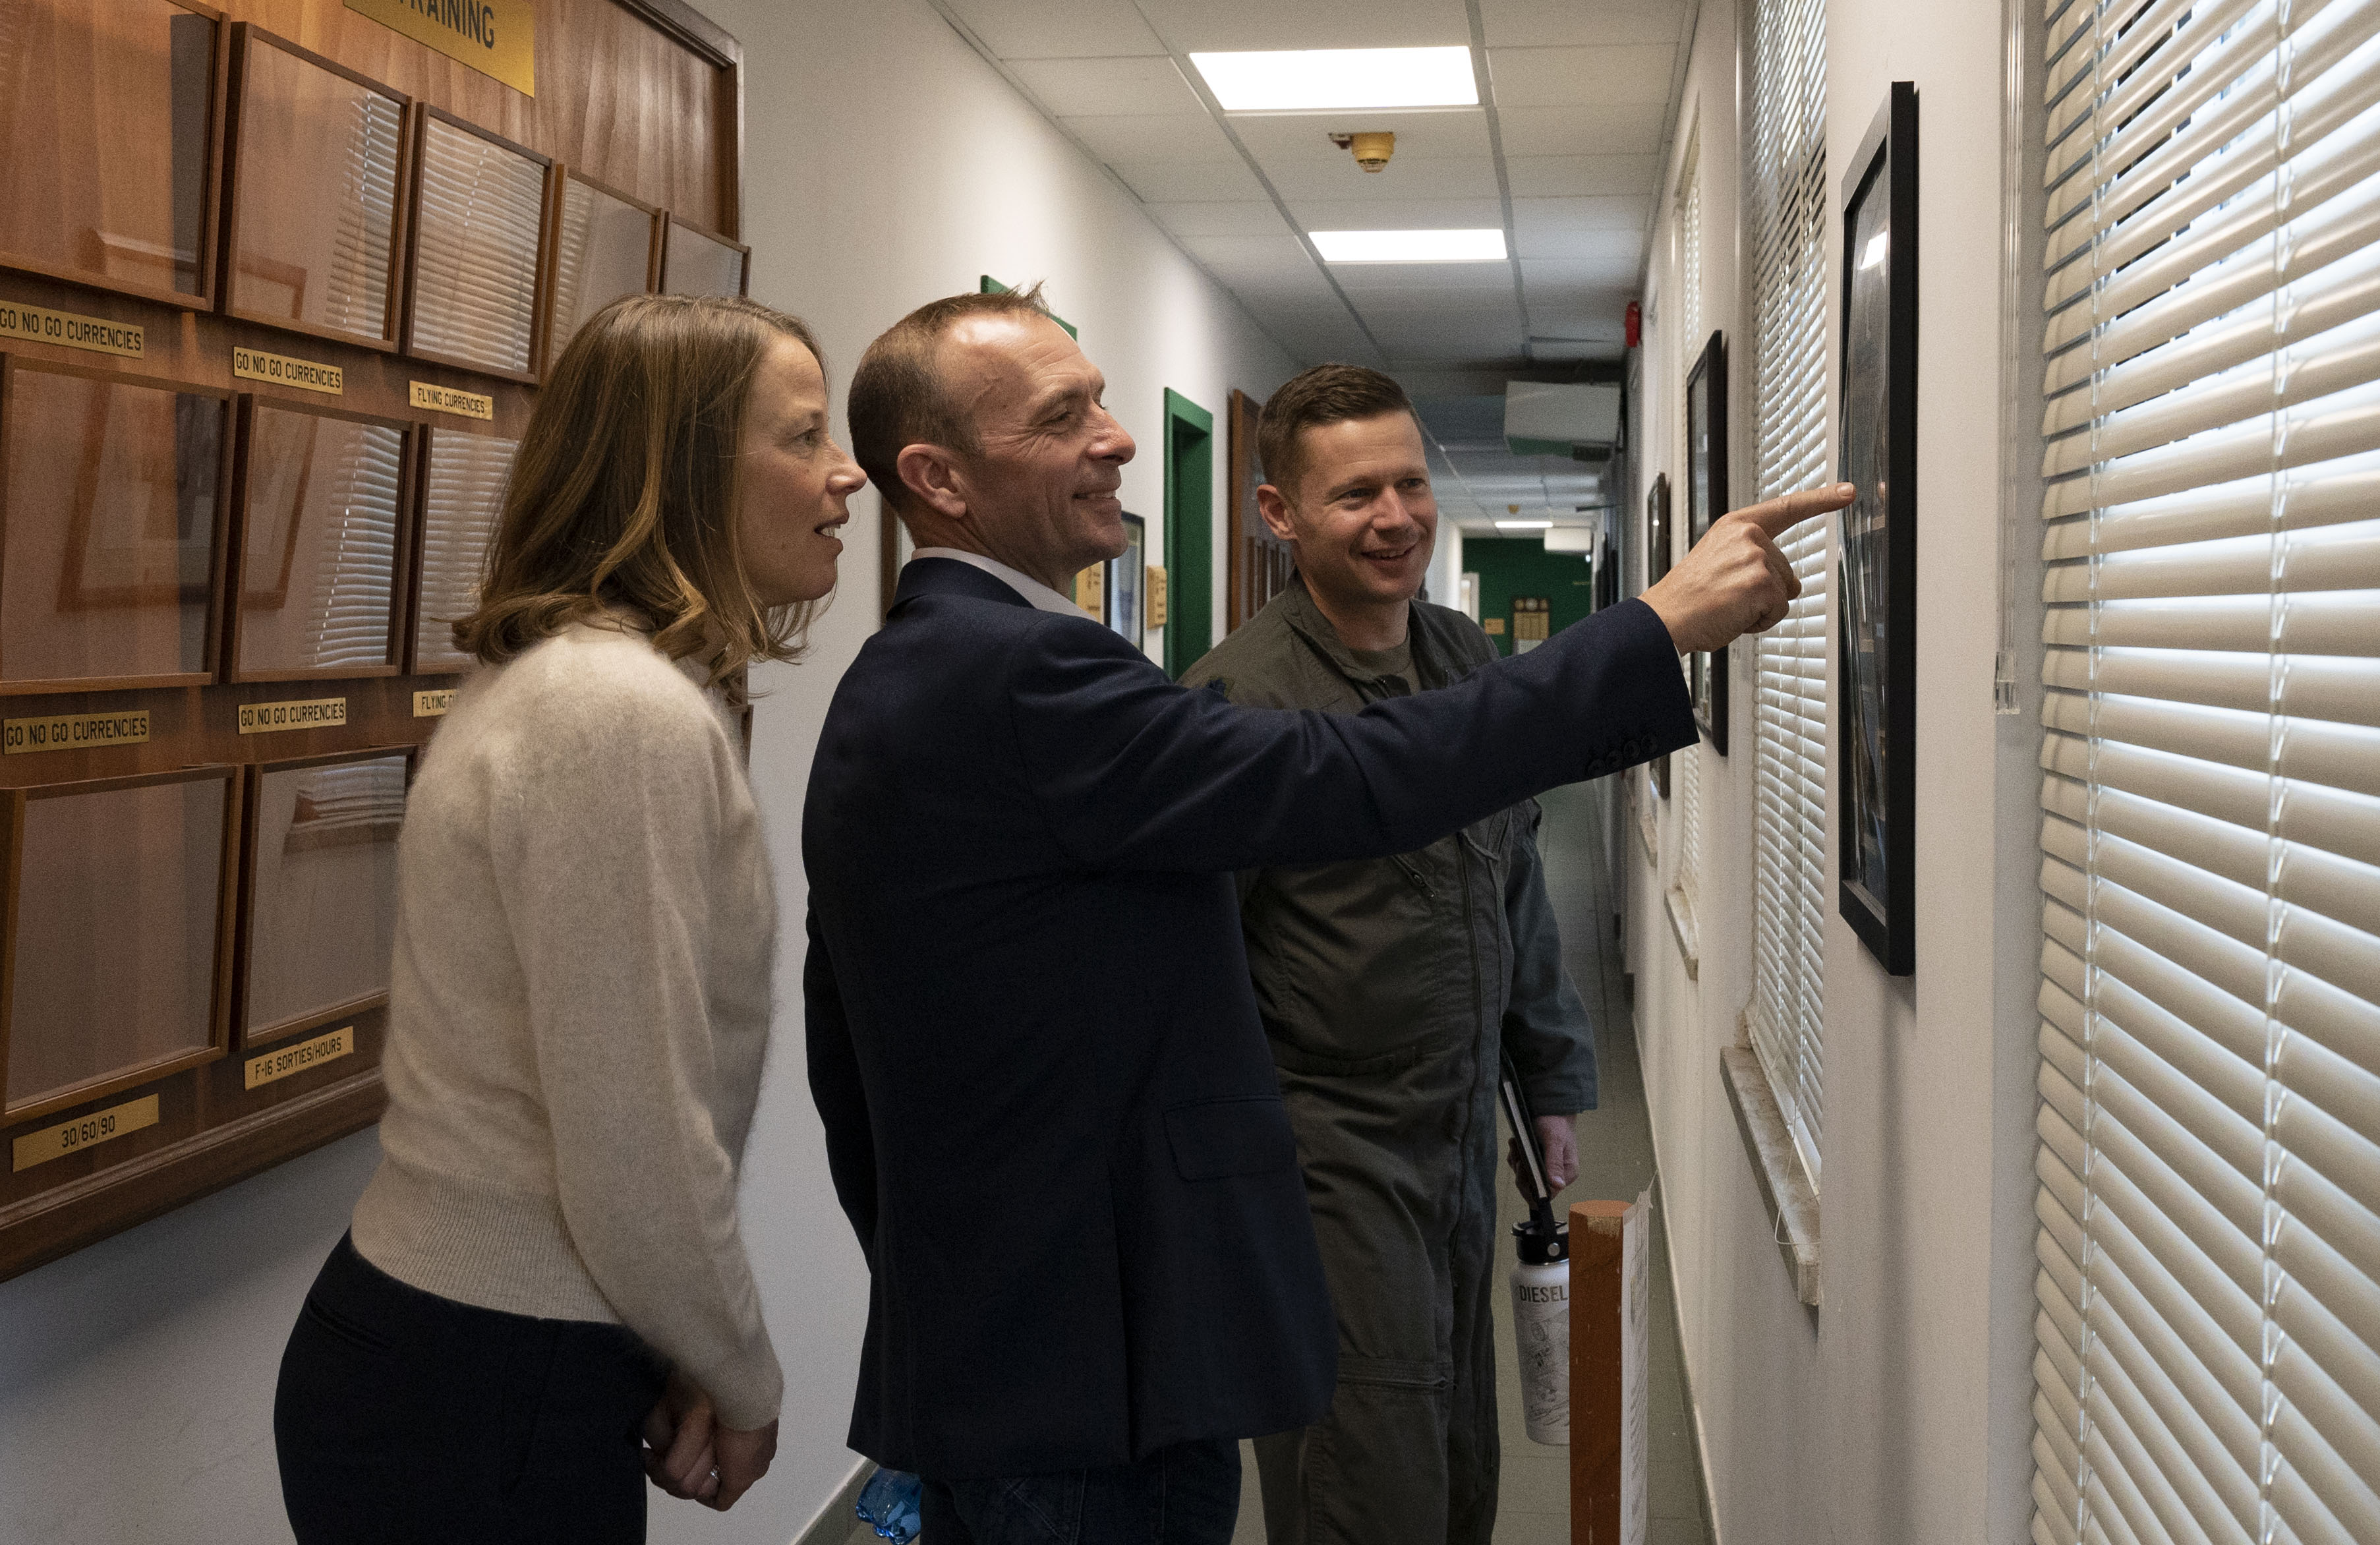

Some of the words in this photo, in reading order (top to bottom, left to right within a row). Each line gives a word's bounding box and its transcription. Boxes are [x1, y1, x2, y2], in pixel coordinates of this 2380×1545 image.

[400, 0, 494, 49] AINING
[0, 308, 16, 329] GO
[22, 311, 39, 334] NO
[45, 316, 61, 337] GO
[67, 320, 142, 351] CURRENCIES
[236, 352, 248, 370] GO
[253, 355, 265, 374] NO
[270, 360, 281, 377] GO
[285, 363, 341, 388] CURRENCIES
[418, 388, 442, 405] FLYING
[444, 394, 484, 413] CURRENCIES
[241, 710, 253, 726] GO
[258, 708, 270, 725] NO
[274, 707, 286, 724] GO
[290, 703, 344, 722] CURRENCIES
[422, 695, 446, 709] FLYING
[7, 726, 22, 746] GO
[30, 724, 45, 744] NO
[52, 723, 68, 742] GO
[73, 717, 147, 740] CURRENCIES
[255, 1059, 274, 1080] F-16
[276, 1037, 341, 1072] SORTIES/HOURS
[62, 1115, 115, 1148] 30/60/90
[1519, 1285, 1568, 1302] DIESEL
